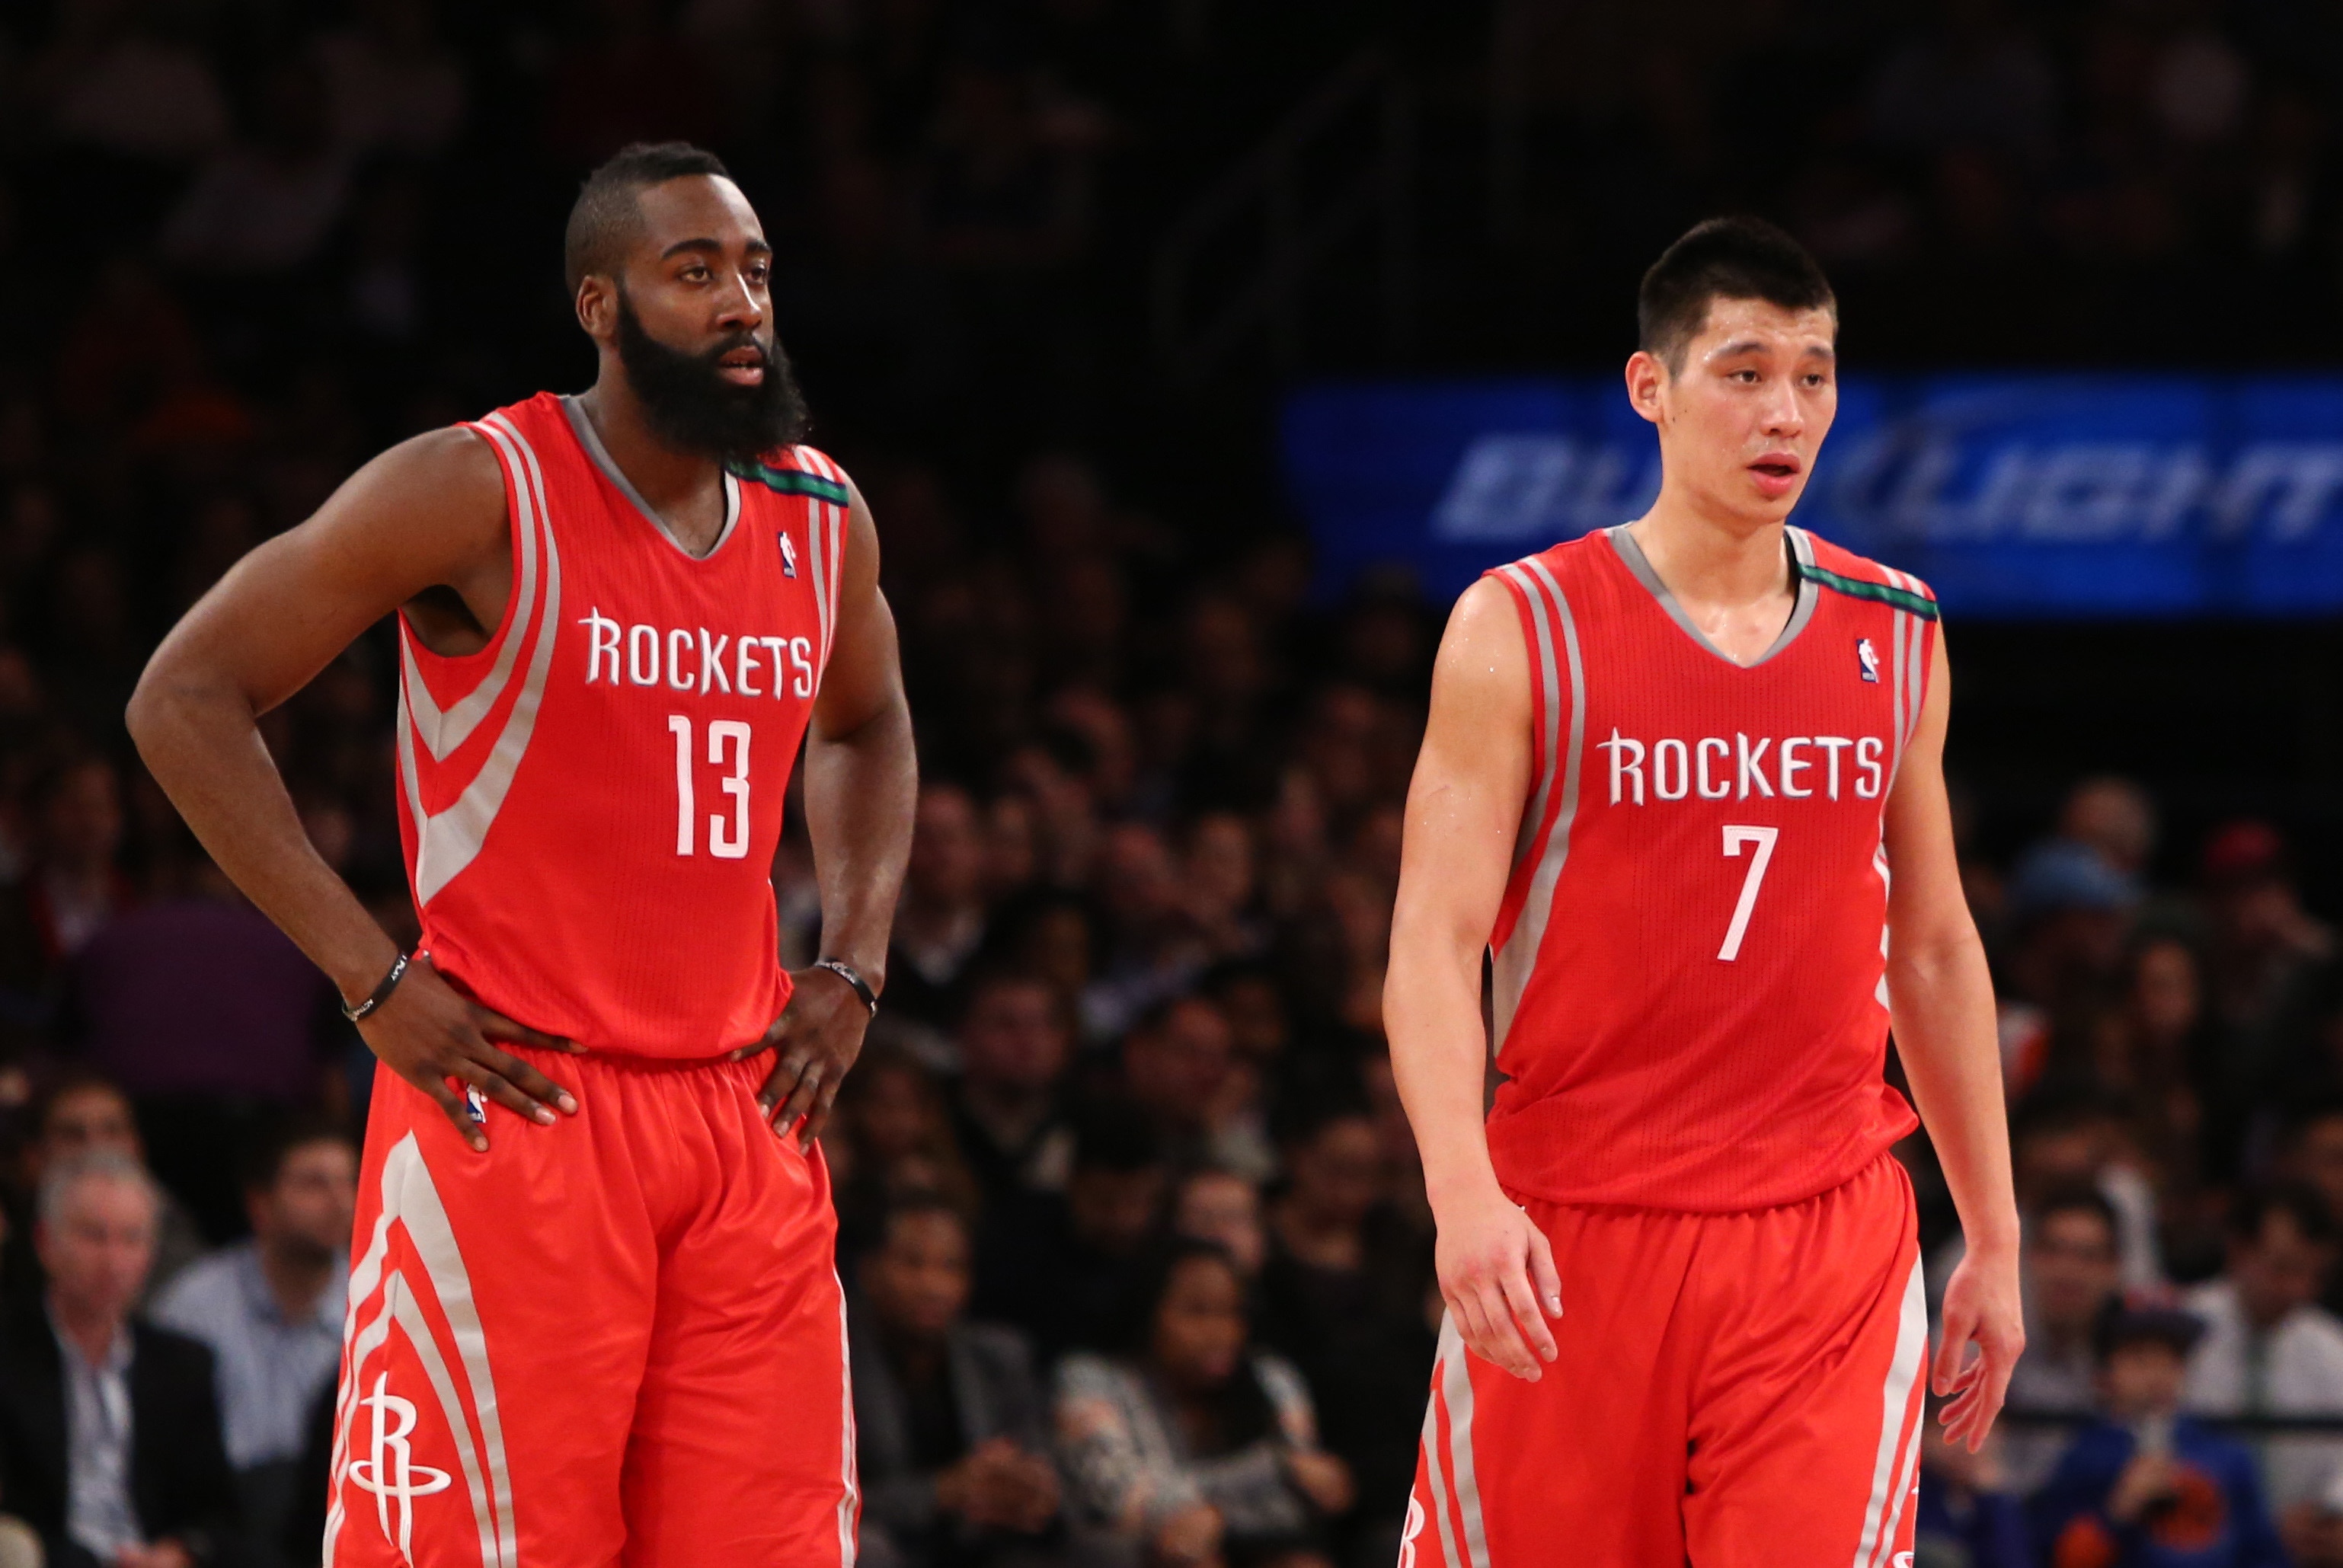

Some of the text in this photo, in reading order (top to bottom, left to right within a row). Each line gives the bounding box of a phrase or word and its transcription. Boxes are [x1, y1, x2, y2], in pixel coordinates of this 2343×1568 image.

[577, 605, 813, 701] ROCKETS
[667, 714, 752, 859] 13
[1595, 726, 1884, 807] ROCKETS
[1716, 824, 1779, 962] 7
